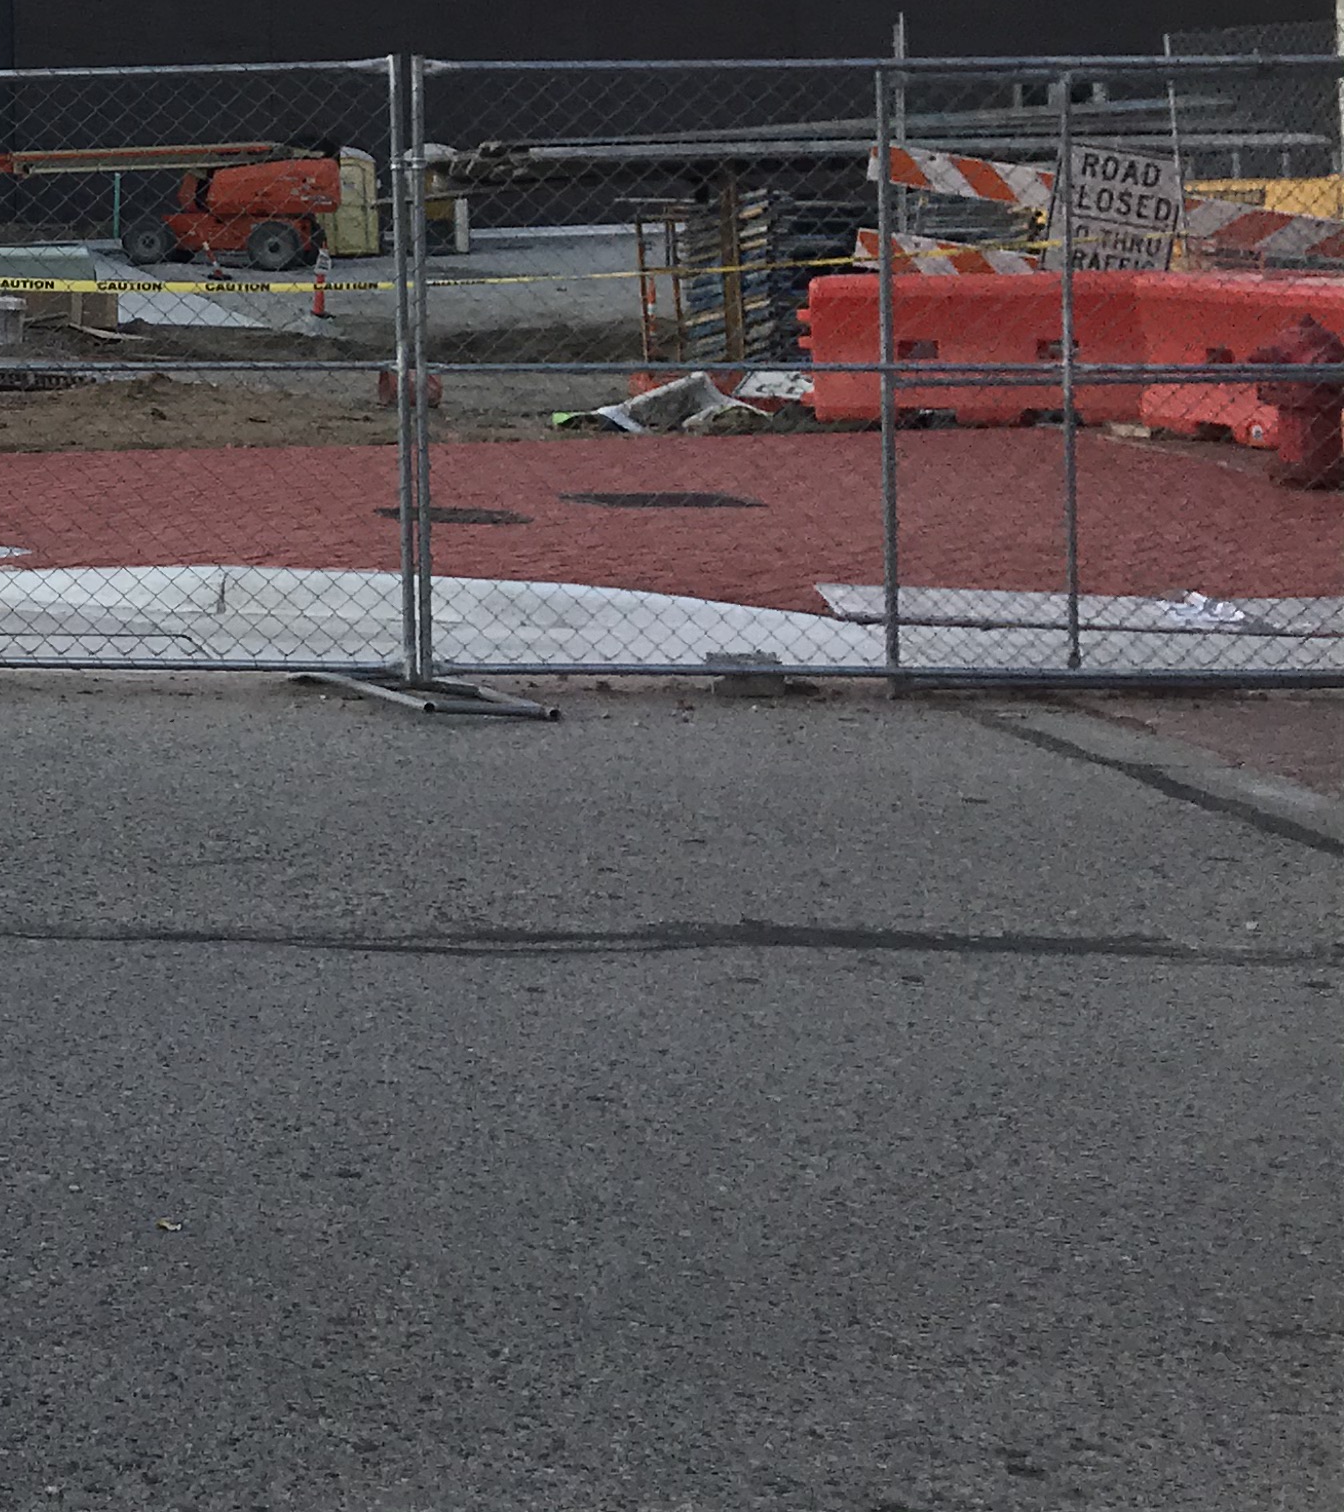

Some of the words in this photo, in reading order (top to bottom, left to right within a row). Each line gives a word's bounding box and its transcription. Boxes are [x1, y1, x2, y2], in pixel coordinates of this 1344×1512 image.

[1081, 152, 1161, 187] ROAD
[1072, 184, 1171, 221] LOSED
[1072, 249, 1155, 270] RAFF
[97, 282, 162, 291] CAUTION
[205, 282, 270, 292] CAUTION
[313, 282, 378, 290] CAUTION
